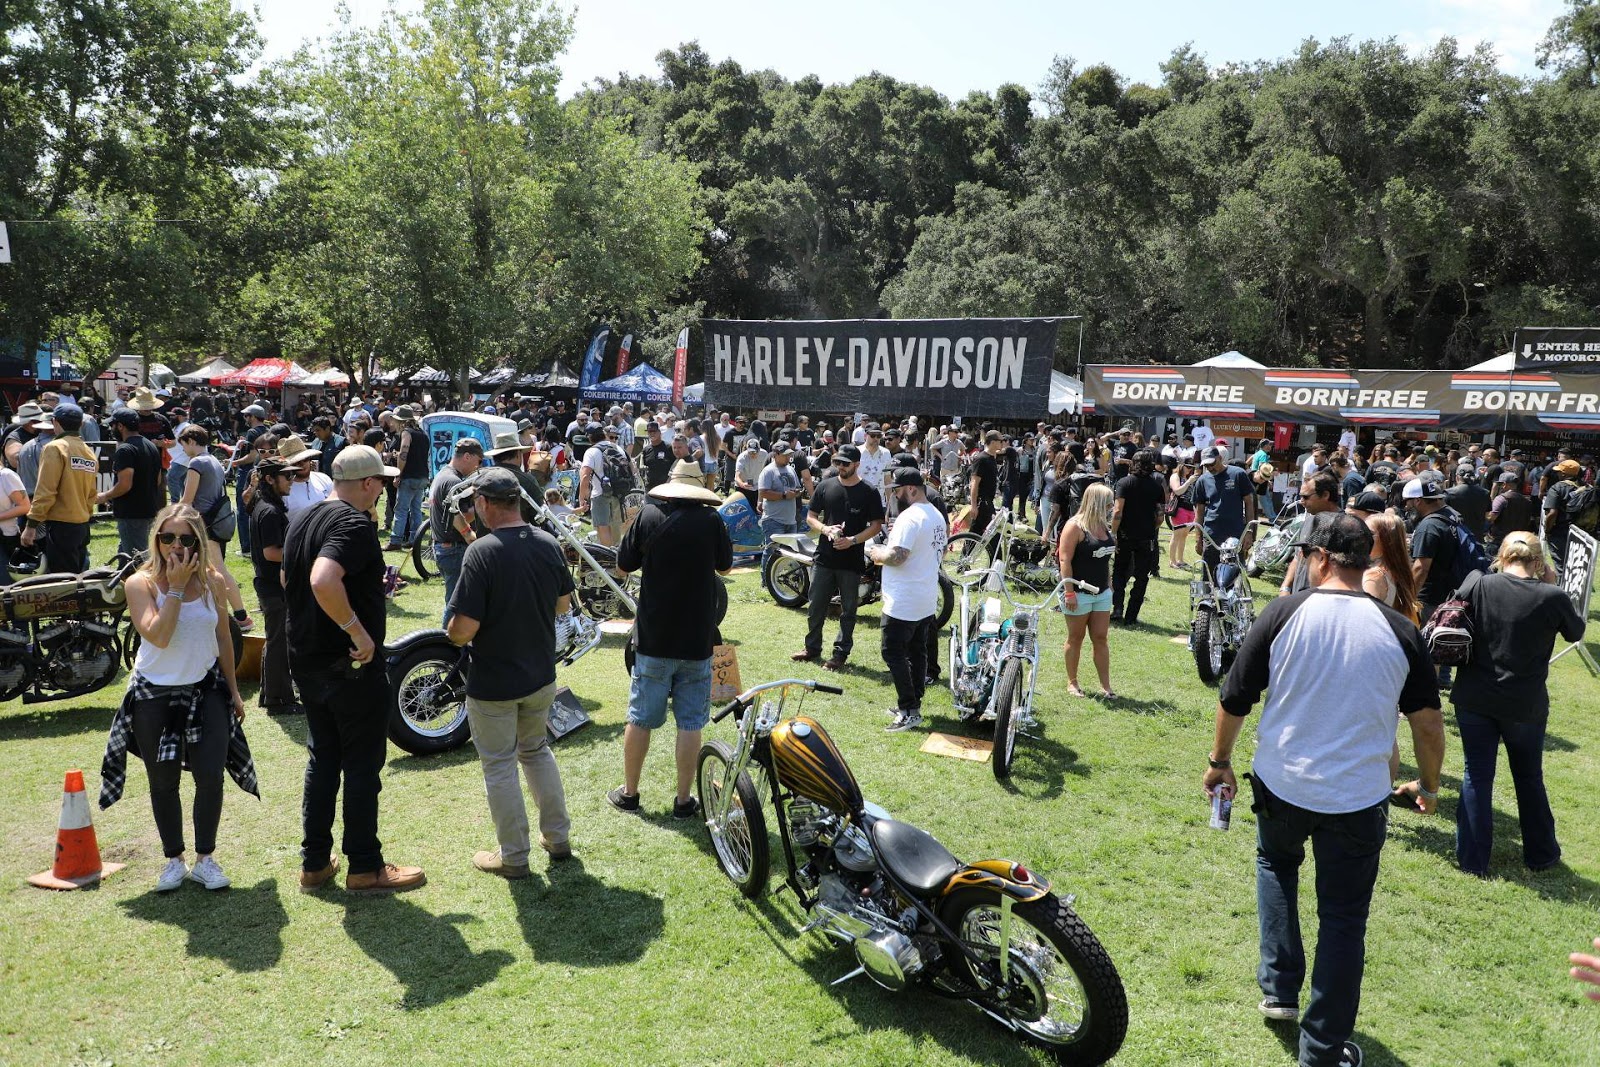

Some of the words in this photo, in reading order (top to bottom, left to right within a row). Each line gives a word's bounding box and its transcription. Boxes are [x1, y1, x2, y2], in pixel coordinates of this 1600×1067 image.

[1536, 342, 1580, 351] ENTER
[713, 333, 1028, 390] HARLEY-DAVIDSON
[583, 391, 637, 400] COKERTIRE.COM
[1112, 382, 1245, 403] BORN-FREE
[1275, 387, 1429, 409] BORN-FREE
[1463, 391, 1600, 413] BORN-FR
